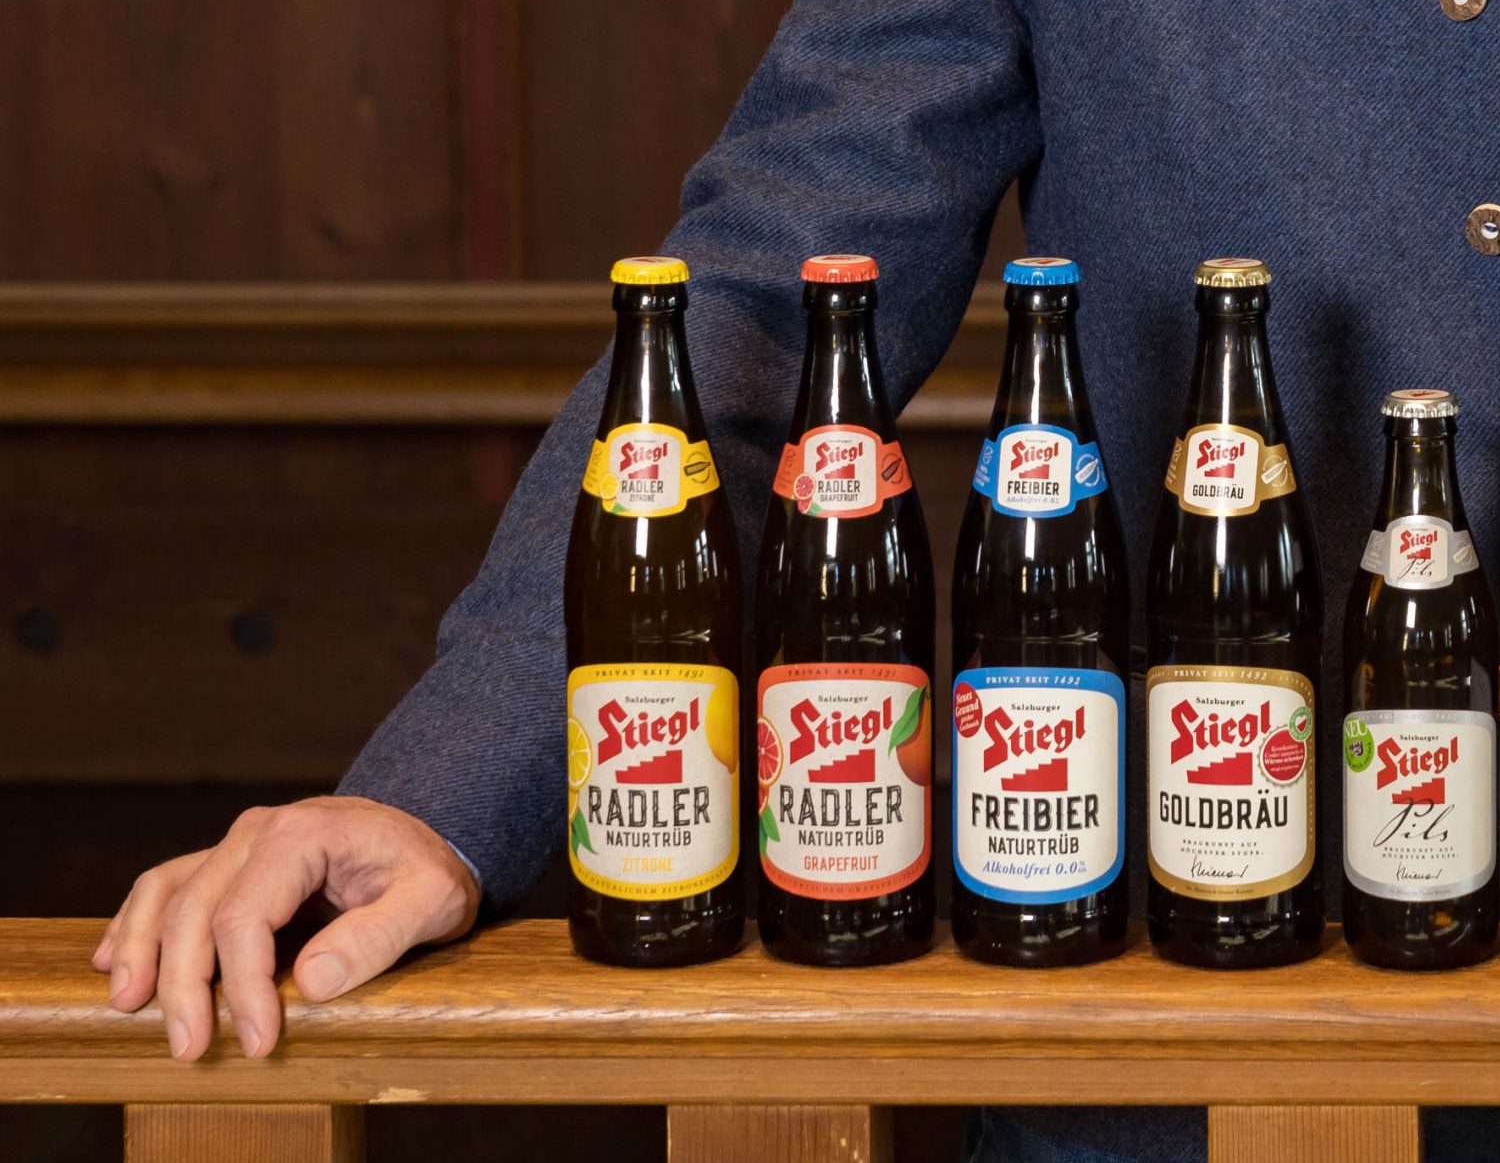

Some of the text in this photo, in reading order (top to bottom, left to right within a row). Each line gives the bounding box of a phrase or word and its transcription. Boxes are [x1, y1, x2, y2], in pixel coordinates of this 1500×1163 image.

[620, 441, 668, 472] Stiegl
[816, 441, 863, 473] Stiegl
[1011, 440, 1059, 472] Stiegl
[1197, 439, 1245, 469] Stiegl
[621, 481, 664, 493] RADLER
[818, 480, 860, 493] RADLER
[1007, 481, 1059, 495] FREIBIER
[1192, 483, 1244, 499] GOLDBRÄU
[820, 494, 858, 502] GRAPEFRUIT
[1400, 530, 1438, 554] Stiegl
[1054, 676, 1081, 685] 1492
[1240, 671, 1268, 680] 1492
[625, 696, 675, 704] Salzburger
[1011, 703, 1061, 713] Salzburger
[1196, 697, 1246, 707] Salzburger
[598, 697, 700, 766] Stiegl
[790, 696, 893, 765] Stiegl
[983, 705, 1086, 773] Stiegl
[1171, 699, 1271, 765] Stiegl
[1377, 736, 1459, 790] Stiegl
[588, 785, 711, 828] RADLER
[779, 784, 903, 827] RADLER
[971, 792, 1100, 833] FREIBIER
[1160, 789, 1288, 829] GOLDBRÄU
[1373, 796, 1455, 847] Pils
[606, 828, 692, 848] NATURTRÜB
[798, 827, 885, 847] NATURTRÜB
[988, 834, 1080, 856] NATURTRÜB
[622, 857, 674, 873] ZITRONE
[803, 855, 879, 872] GRAPEFRUIT
[982, 861, 1051, 879] Alkoholfrei
